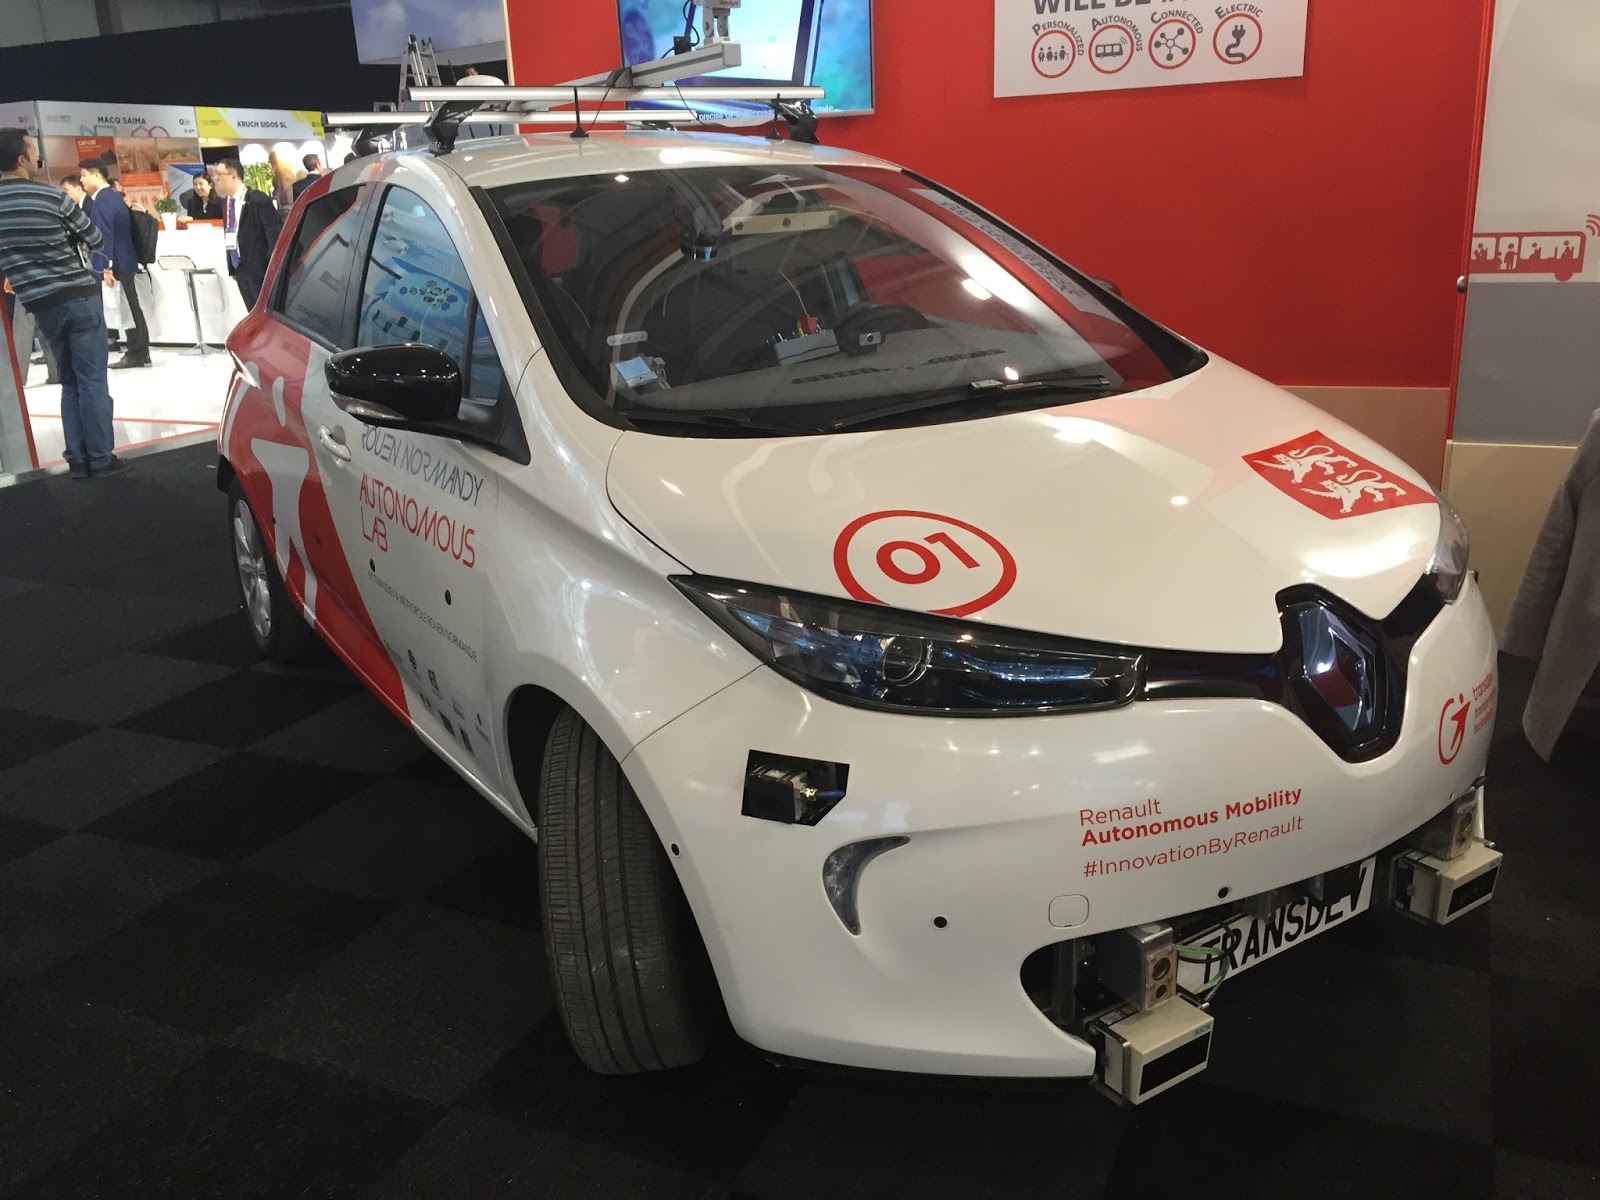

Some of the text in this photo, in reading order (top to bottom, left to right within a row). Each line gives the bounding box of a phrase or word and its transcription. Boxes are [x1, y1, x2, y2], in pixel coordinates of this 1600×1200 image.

[1150, 9, 1204, 34] CONNECTED
[1214, 2, 1263, 20] ELECTRIC
[1031, 20, 1085, 57] PERSONALIZED
[1091, 15, 1143, 52] AUTONOMOUS
[123, 117, 147, 125] SAIMA
[237, 120, 259, 128] KRUCH
[260, 121, 279, 129] SIDOS
[361, 422, 484, 507] ROUEN NORMANDY
[359, 472, 476, 569] AUTONOMOUS
[360, 506, 388, 553] LAB
[875, 531, 981, 585] 01
[1079, 798, 1162, 827] Renault
[1080, 788, 1302, 847] Autonomous Mobility
[1083, 815, 1304, 878] #InnovationByRenault
